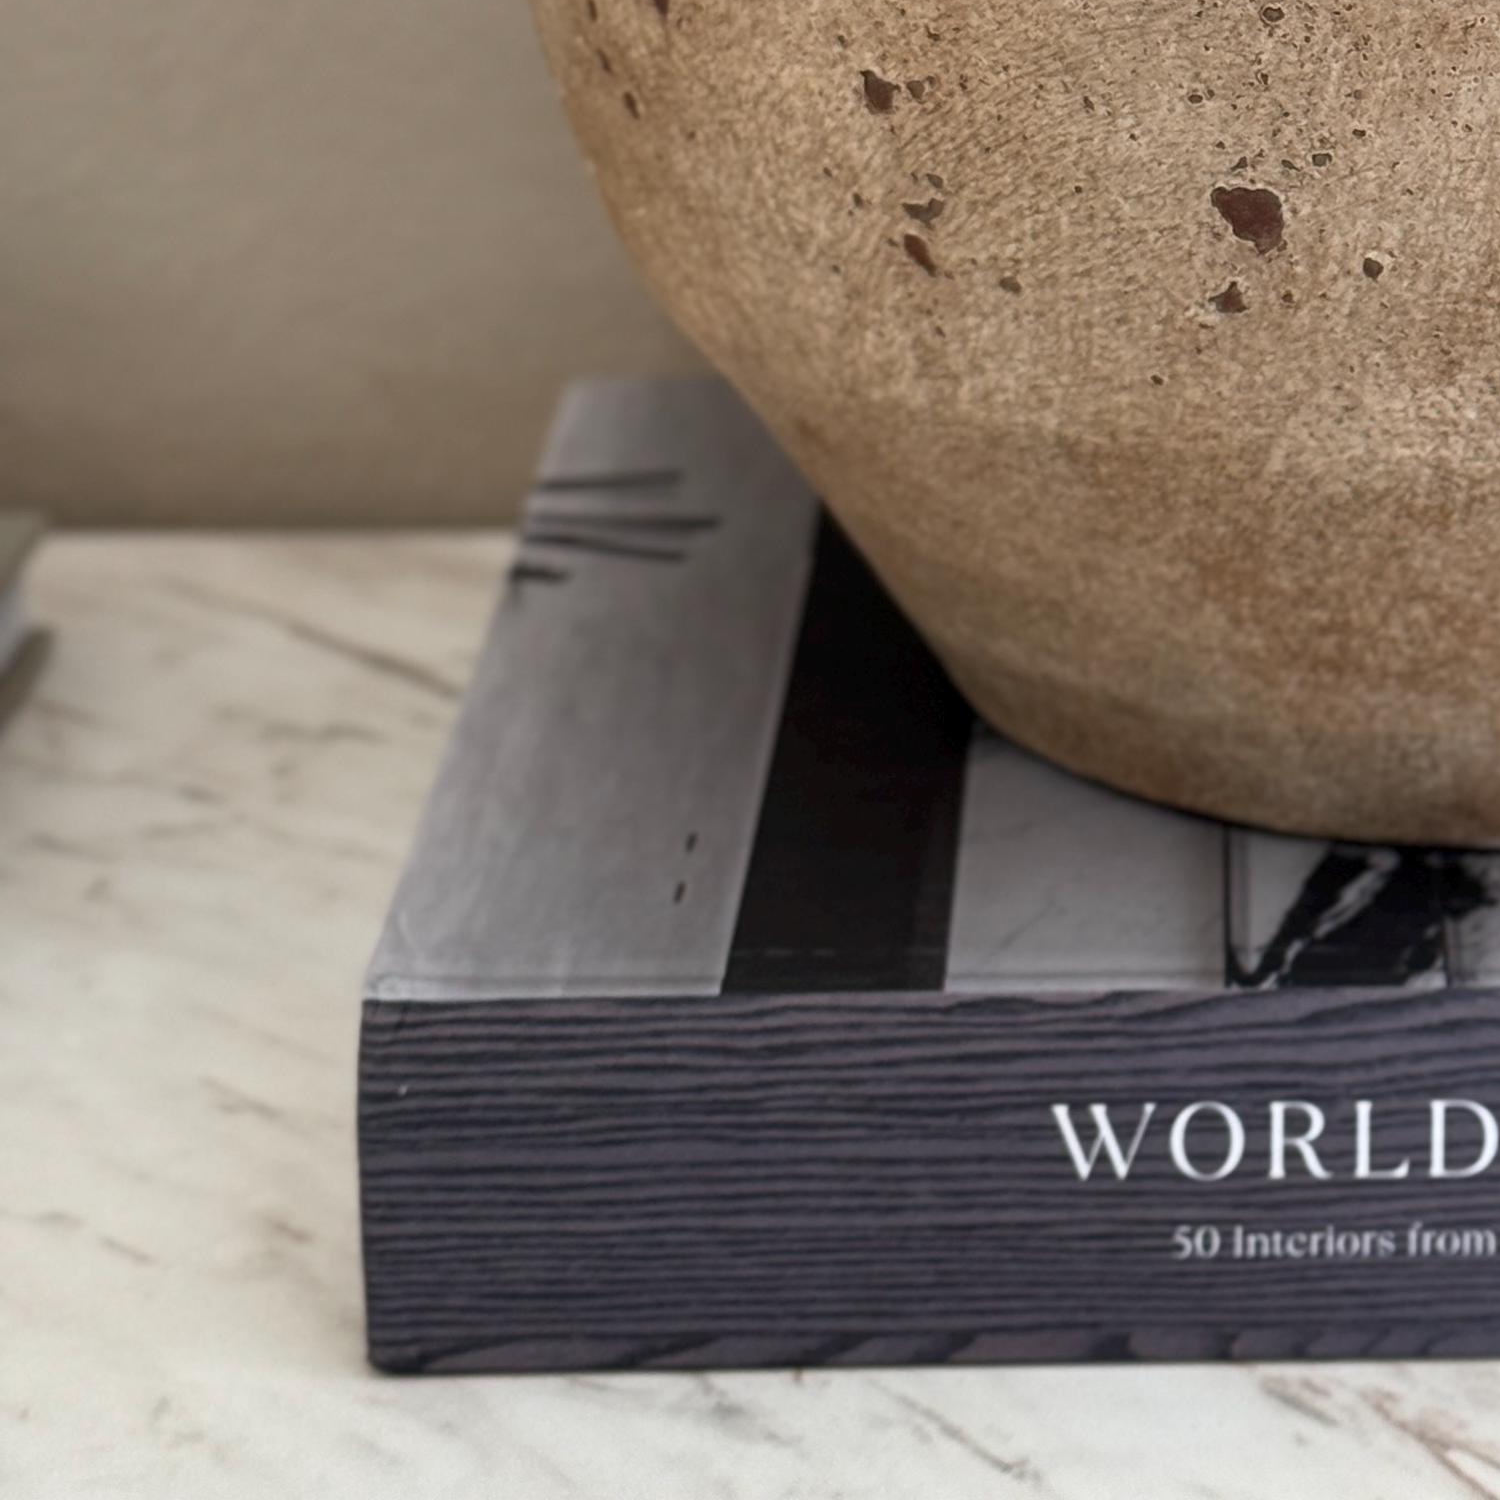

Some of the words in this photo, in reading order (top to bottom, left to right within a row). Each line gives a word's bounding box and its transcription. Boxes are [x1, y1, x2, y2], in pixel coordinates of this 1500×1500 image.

[1172, 1225, 1221, 1260] 50
[1232, 1223, 1397, 1259] Interiors
[1406, 1220, 1498, 1257] from
